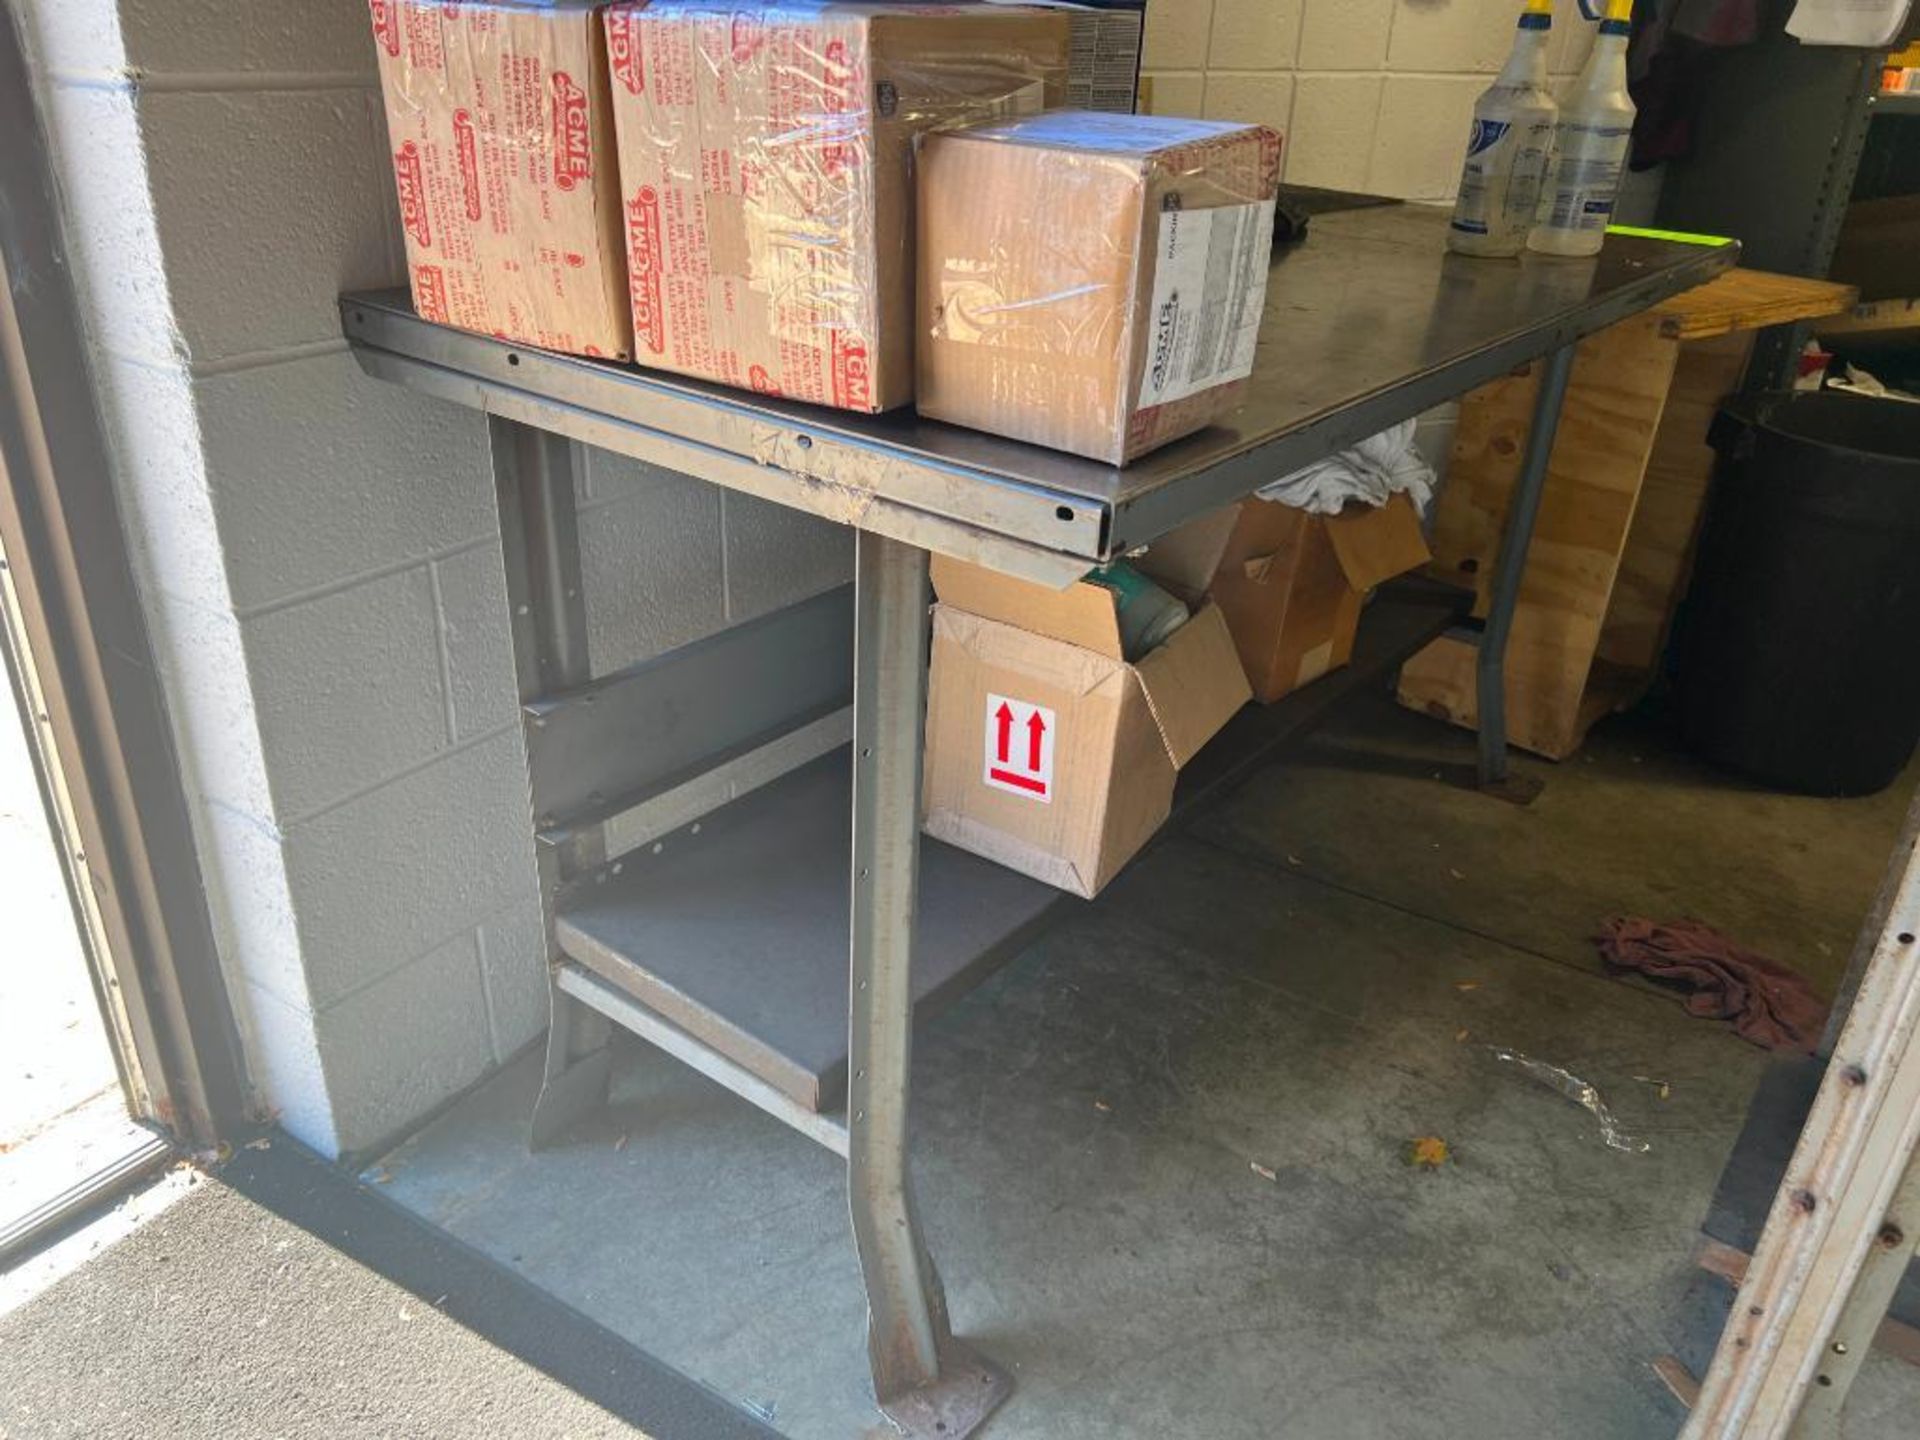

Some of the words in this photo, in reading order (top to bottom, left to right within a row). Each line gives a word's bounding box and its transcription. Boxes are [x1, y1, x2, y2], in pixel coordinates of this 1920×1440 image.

[610, 10, 632, 84] ACM
[565, 83, 589, 173] ACME
[398, 159, 422, 239] ACME
